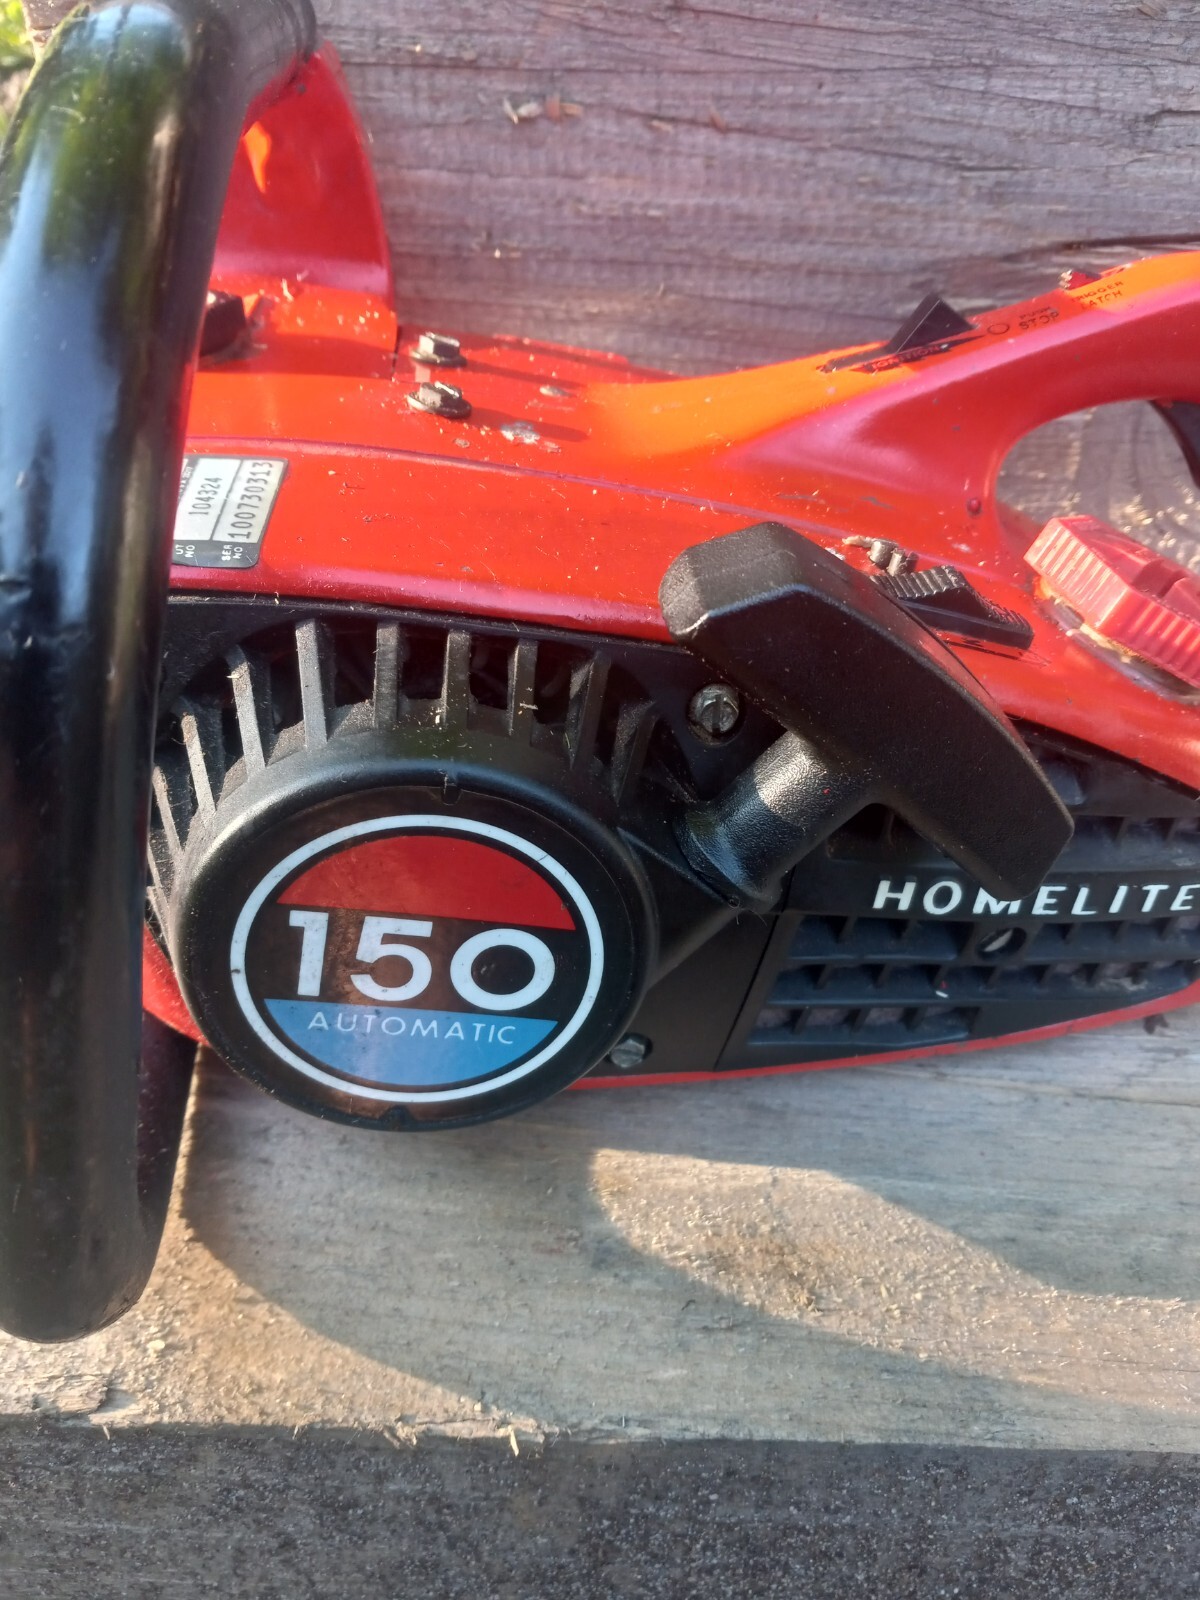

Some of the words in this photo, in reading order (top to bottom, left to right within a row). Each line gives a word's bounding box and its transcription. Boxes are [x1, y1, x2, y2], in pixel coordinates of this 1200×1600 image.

[1072, 281, 1124, 303] TRIGGER
[1081, 290, 1122, 310] LATCH
[1019, 311, 1060, 330] STOP
[188, 477, 222, 515] 104324
[227, 461, 273, 539] 100730313
[185, 545, 195, 557] NO
[233, 547, 243, 559] NO
[872, 880, 1200, 915] HOMELITE
[288, 909, 556, 1011] 150
[307, 1011, 517, 1045] AUTOMATIC
